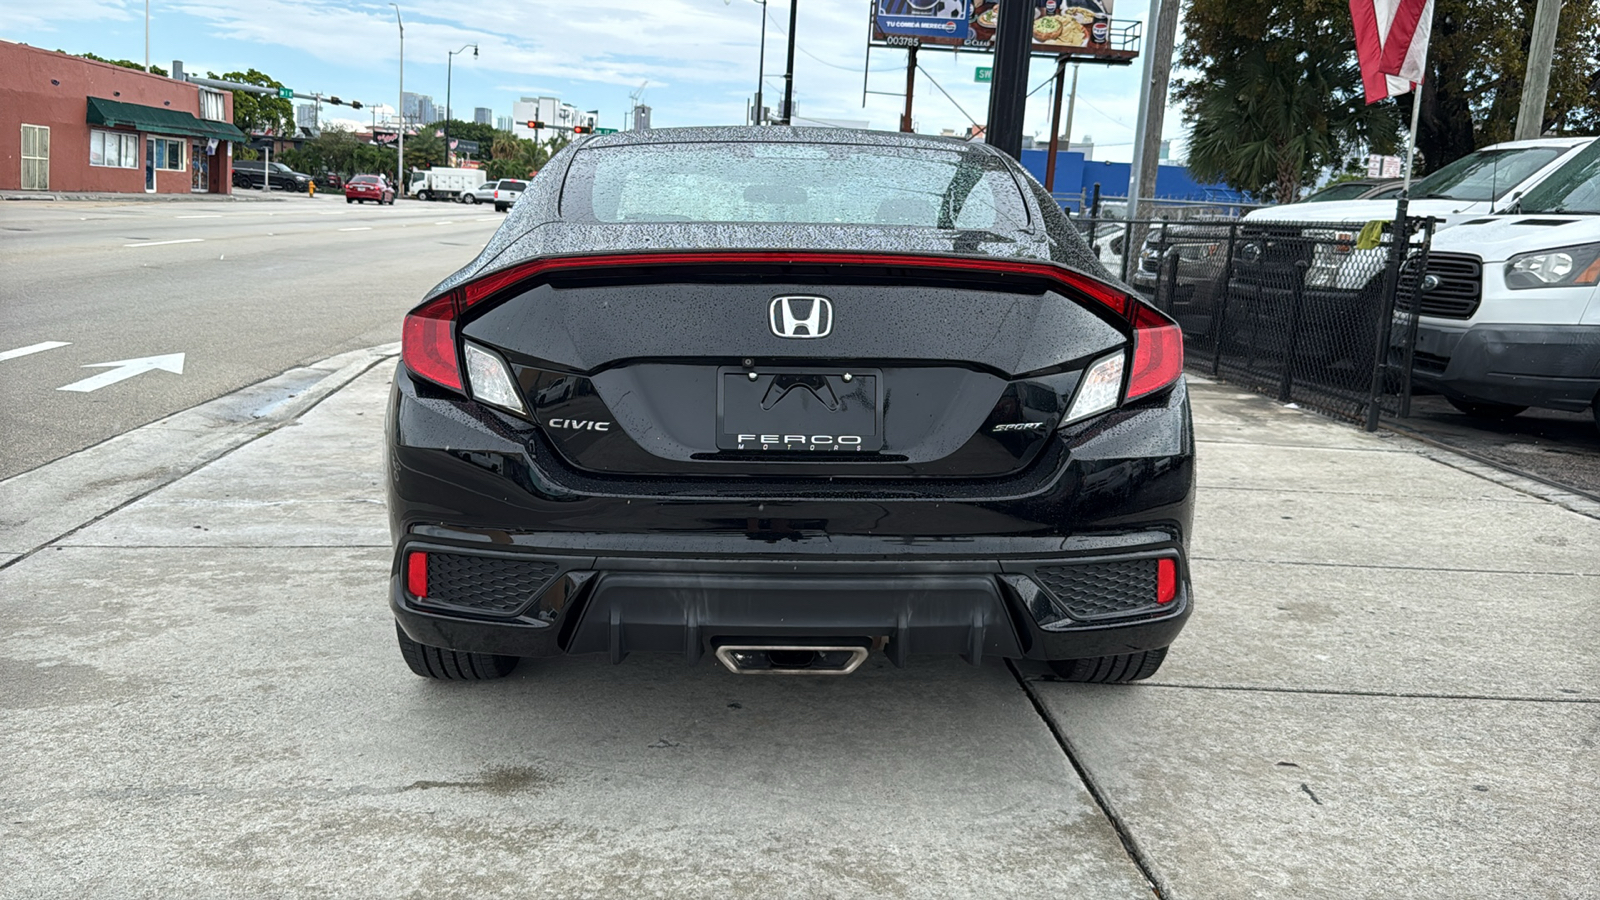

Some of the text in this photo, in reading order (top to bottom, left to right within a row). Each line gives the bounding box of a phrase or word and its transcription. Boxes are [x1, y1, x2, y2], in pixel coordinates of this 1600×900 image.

[887, 36, 919, 47] 003785
[979, 70, 992, 79] SW
[549, 418, 611, 432] CIVIC
[992, 422, 1043, 432] SPORT
[737, 434, 862, 444] FERCO
